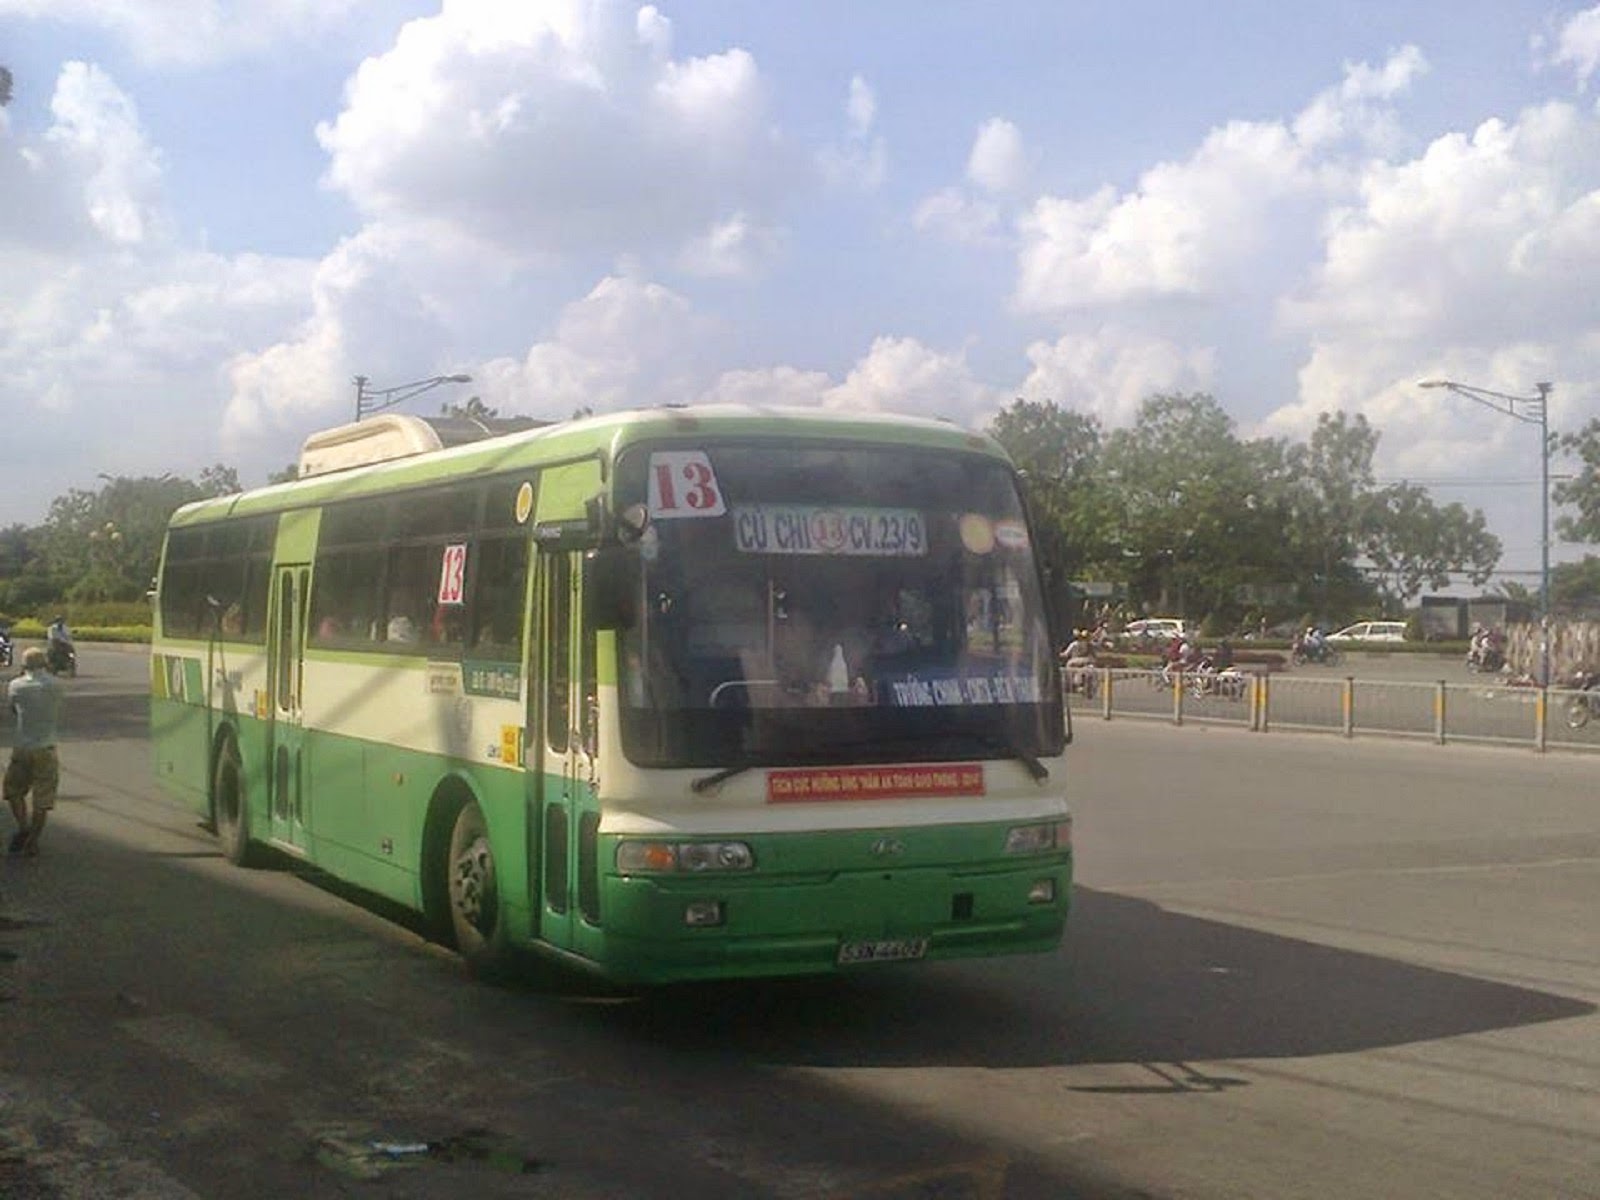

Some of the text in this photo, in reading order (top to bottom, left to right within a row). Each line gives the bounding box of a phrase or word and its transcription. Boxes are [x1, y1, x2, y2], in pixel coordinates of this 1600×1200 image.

[655, 462, 716, 510] 13
[774, 511, 811, 549] CHI
[441, 546, 464, 601] 13
